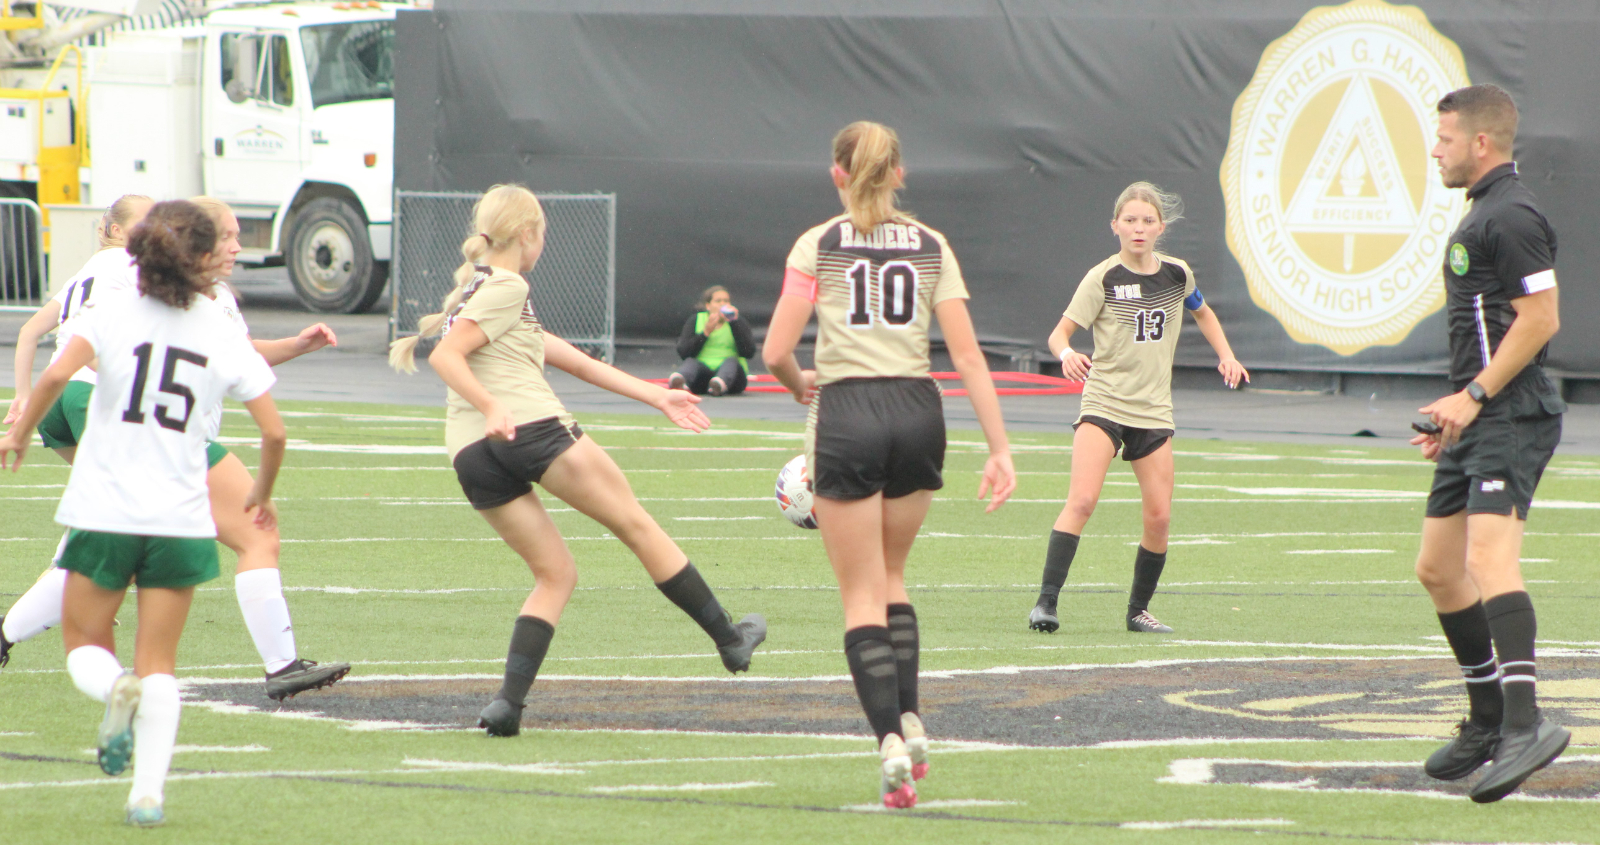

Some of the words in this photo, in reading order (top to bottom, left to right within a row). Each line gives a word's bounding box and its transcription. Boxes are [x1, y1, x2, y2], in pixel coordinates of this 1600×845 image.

[1255, 46, 1336, 158] WARREN
[1382, 43, 1441, 124] HARD
[236, 138, 284, 150] WARREN
[1315, 128, 1344, 180] MERIT
[1362, 115, 1394, 191] SUCCESS
[1312, 207, 1393, 221] EFFICIENCY
[1253, 193, 1310, 294] SENIOR
[1313, 288, 1373, 312] HIGH
[1379, 196, 1453, 302] SCHOOL
[61, 276, 95, 324] 11
[845, 259, 918, 329] 10
[1134, 309, 1165, 343] 13
[121, 341, 208, 434] 15
